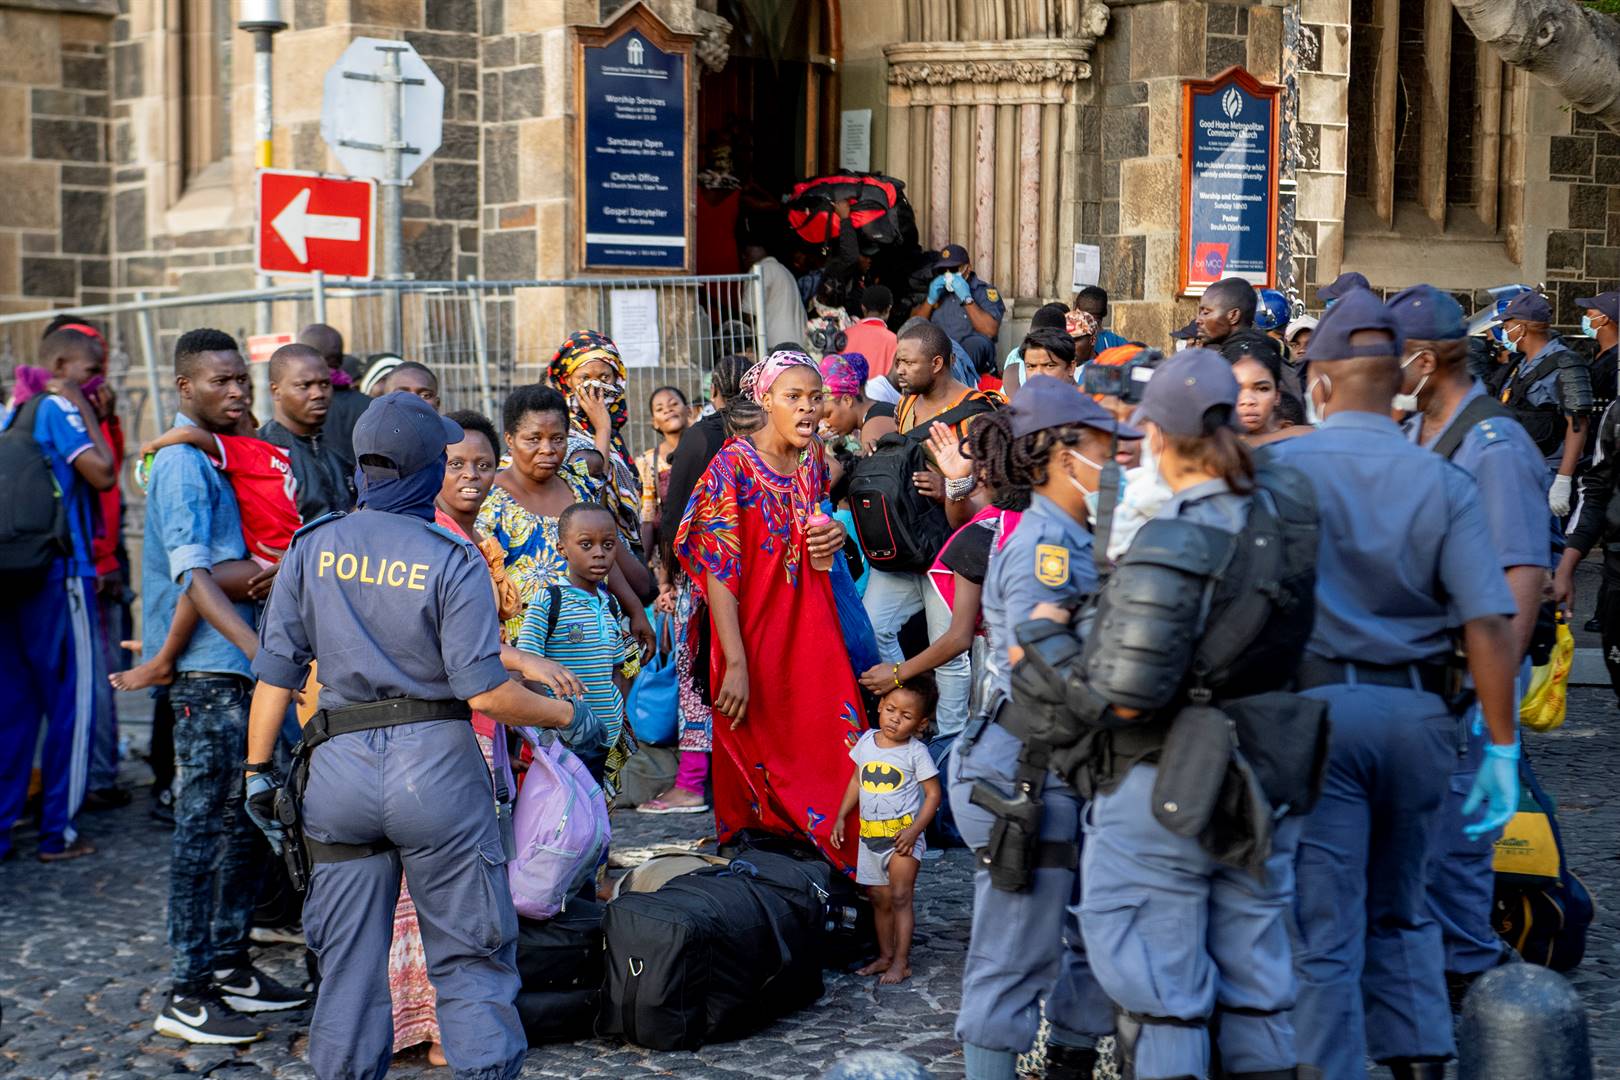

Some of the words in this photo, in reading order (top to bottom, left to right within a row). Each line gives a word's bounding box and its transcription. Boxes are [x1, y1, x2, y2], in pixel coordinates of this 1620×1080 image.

[605, 94, 635, 105] Worship
[636, 96, 666, 106] Services
[1199, 119, 1214, 128] Good
[1215, 120, 1230, 130] Hope
[1230, 121, 1265, 131] Metropolitan
[1207, 128, 1238, 138] Community
[1238, 129, 1258, 139] Church
[606, 136, 642, 148] Sanctuary
[643, 138, 664, 148] Open
[1224, 163, 1251, 172] community
[610, 172, 637, 181] Church
[638, 172, 660, 183] Office
[1242, 173, 1263, 181] diversity
[1199, 191, 1220, 201] Worship
[1221, 192, 1232, 200] and
[1232, 193, 1262, 201] Communion
[1214, 202, 1232, 211] Sunday
[603, 206, 629, 217] Gospel
[630, 207, 668, 219] Storyteller
[318, 551, 430, 590] POLICE
